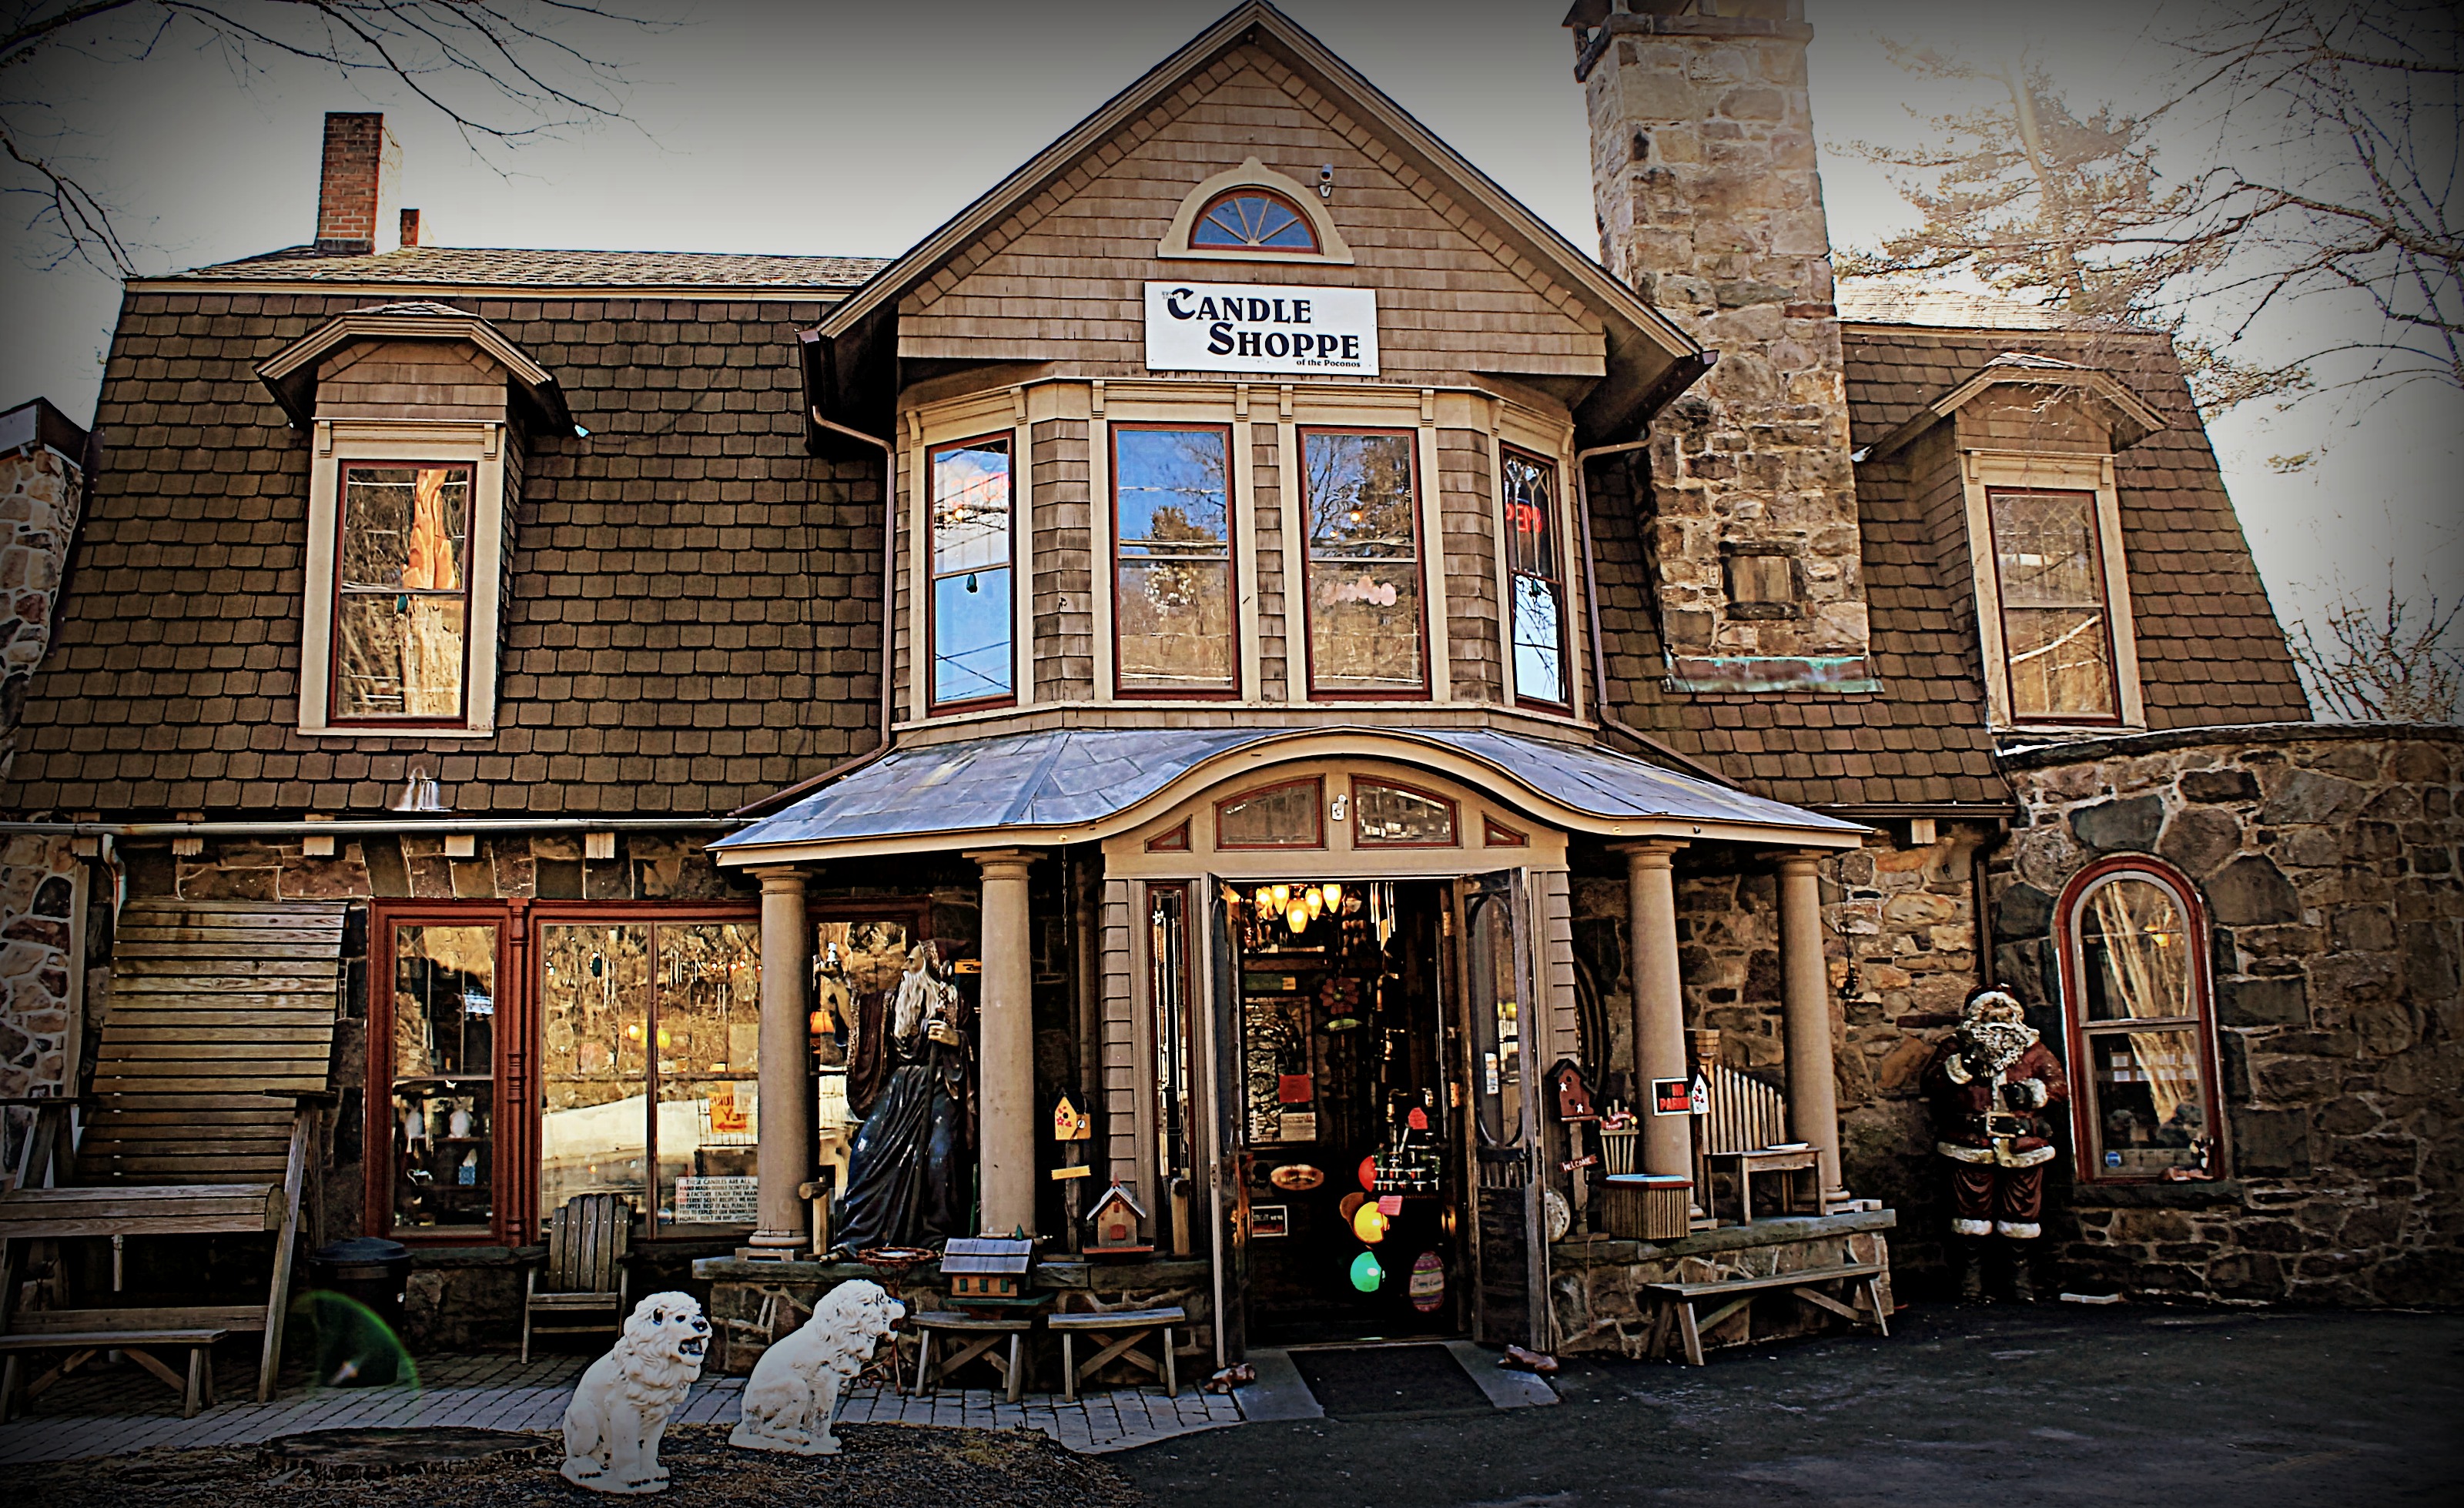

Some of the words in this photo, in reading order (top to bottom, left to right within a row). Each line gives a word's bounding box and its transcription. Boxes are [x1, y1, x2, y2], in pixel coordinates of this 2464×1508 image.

[1167, 287, 1311, 324] CANDLE
[1207, 322, 1359, 359] SHOPPE
[1324, 359, 1361, 368] Poconos
